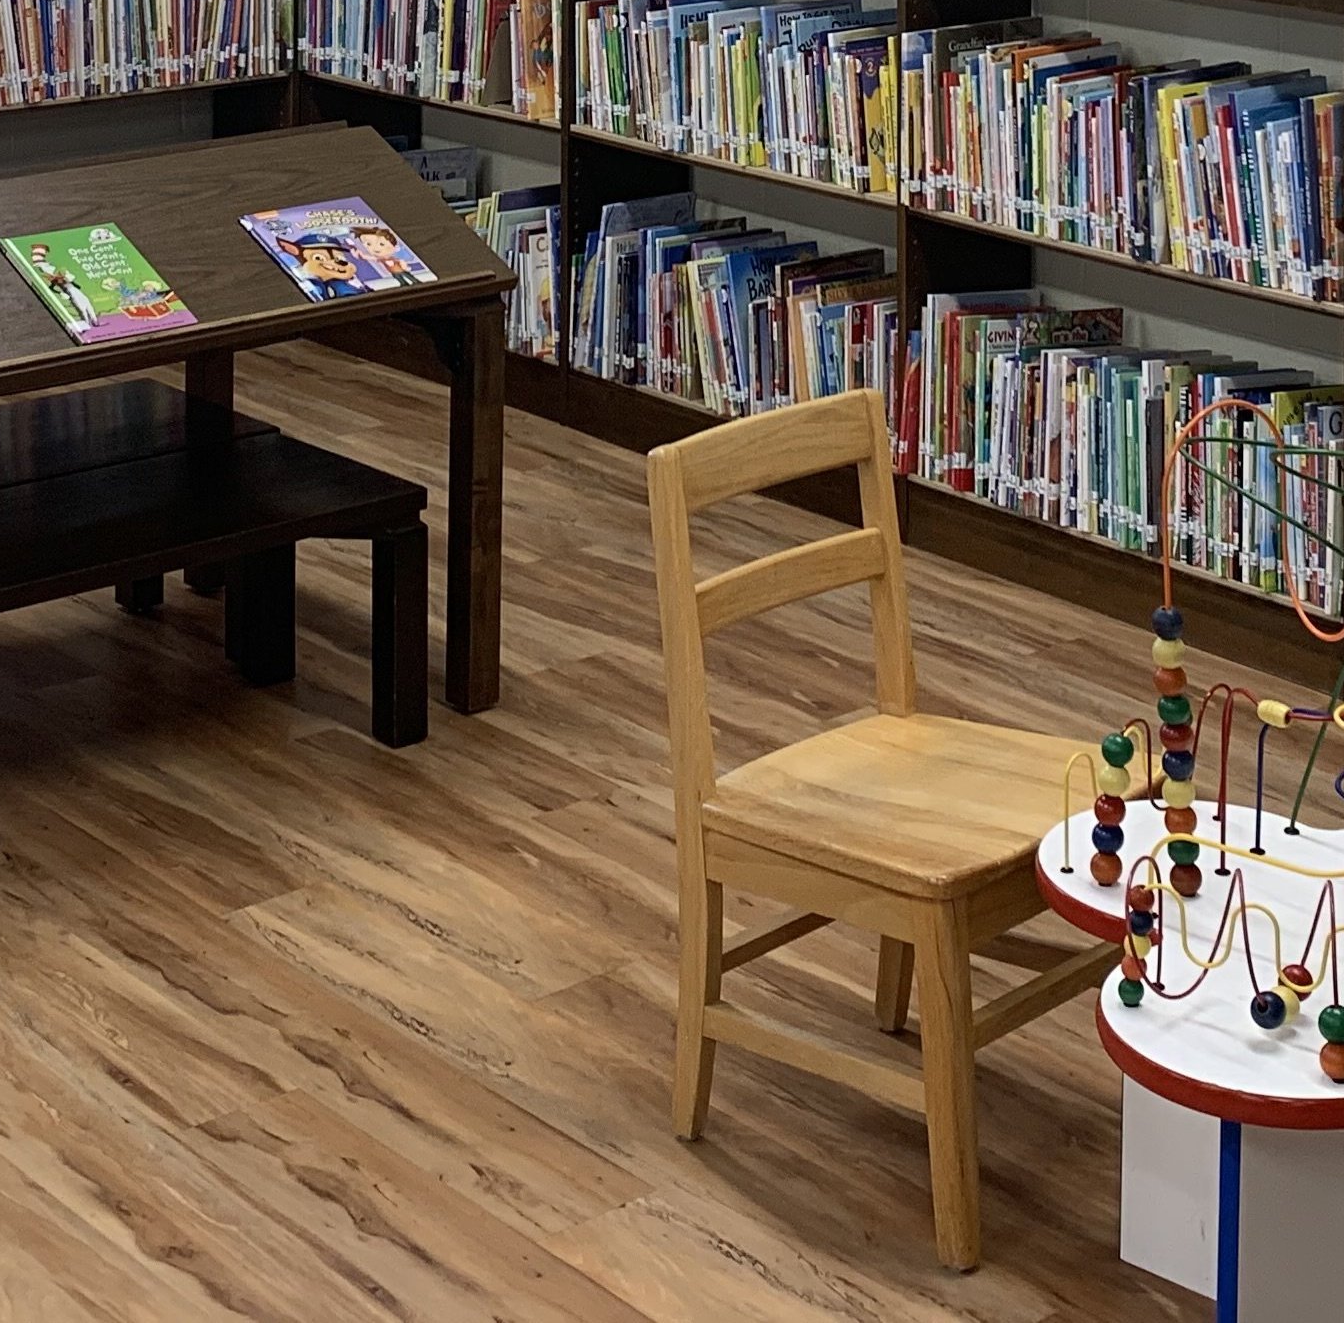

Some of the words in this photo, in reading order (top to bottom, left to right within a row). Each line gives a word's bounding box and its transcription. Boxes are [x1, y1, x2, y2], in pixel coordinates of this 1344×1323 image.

[67, 246, 89, 257] One
[71, 255, 94, 265] Two
[81, 262, 101, 273] Old
[84, 270, 108, 280] New
[108, 266, 134, 277] Cent
